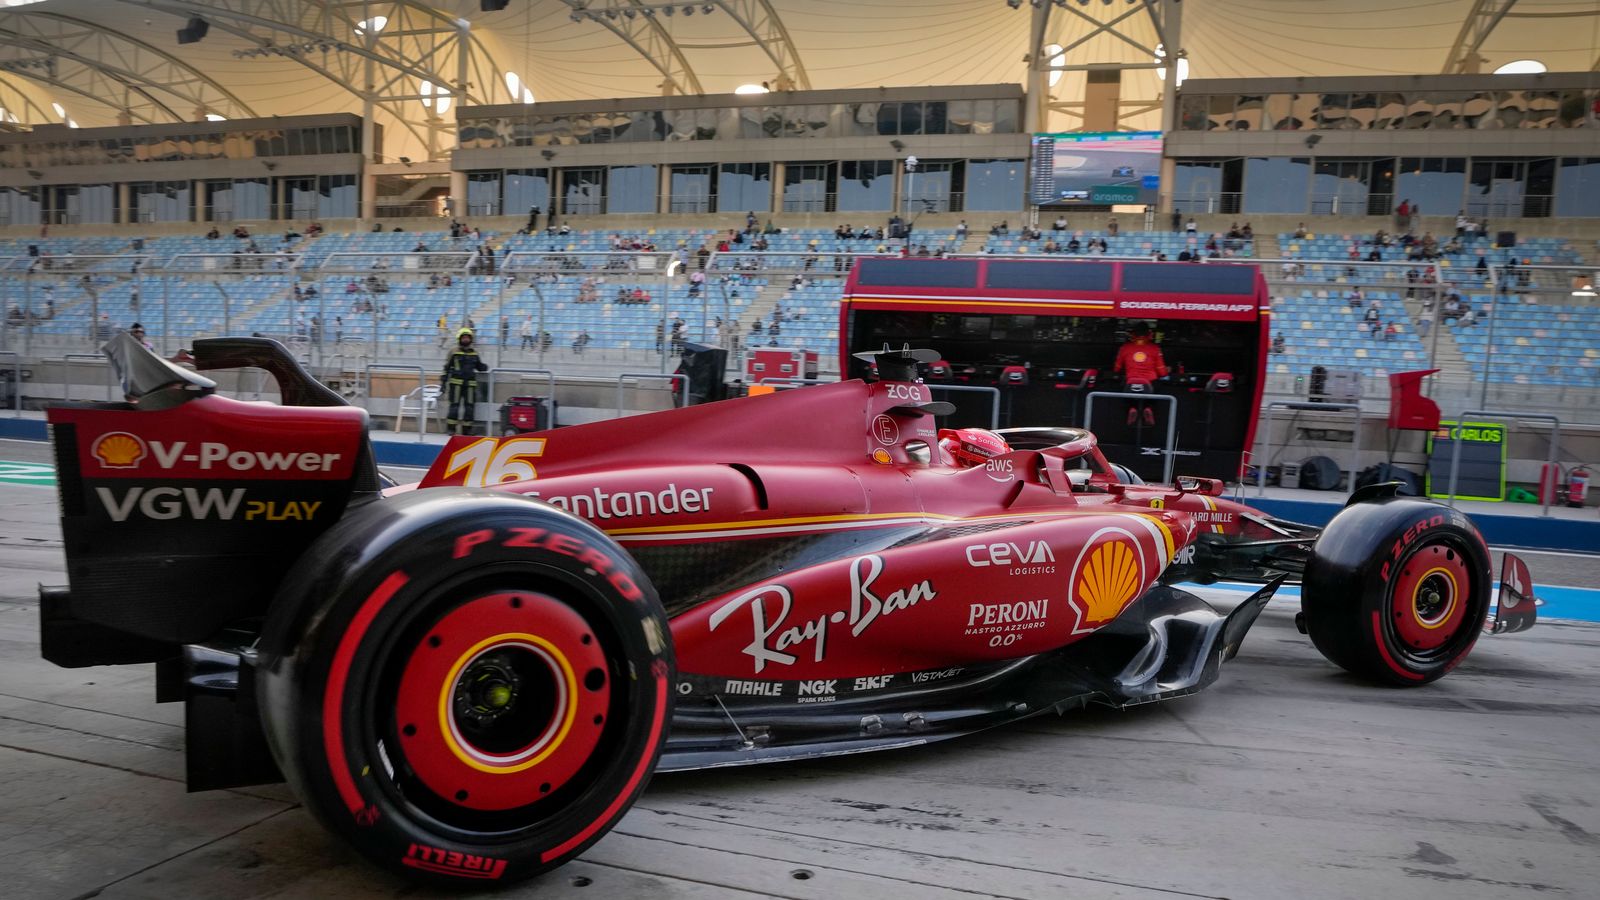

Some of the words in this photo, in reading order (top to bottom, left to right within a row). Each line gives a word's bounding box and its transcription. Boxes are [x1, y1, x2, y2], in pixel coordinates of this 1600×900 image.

[1093, 193, 1135, 201] aramco
[1119, 301, 1178, 310] SCUDERIA
[1177, 303, 1228, 311] FERRARI
[1227, 304, 1254, 312] APP
[1450, 427, 1502, 442] CARLOS
[148, 440, 341, 472] V-Power
[443, 437, 547, 489] 16
[986, 459, 1013, 472] aws
[95, 487, 247, 522] VGW
[245, 502, 322, 521] PLAY
[1210, 512, 1233, 522] MILLE
[1392, 515, 1444, 560] ZERO
[453, 528, 496, 559] P
[502, 527, 644, 602] ZERO
[1009, 566, 1056, 576] LOGISTICS
[967, 599, 1049, 626] PERONI
[964, 626, 1003, 635] NASTRO
[1004, 621, 1046, 632] AZZURRO
[725, 680, 783, 696] MAHLE
[798, 679, 838, 696] NGK
[853, 674, 895, 691] SKF
[817, 695, 836, 703] PLUGS
[402, 843, 509, 880] PIRELLI
